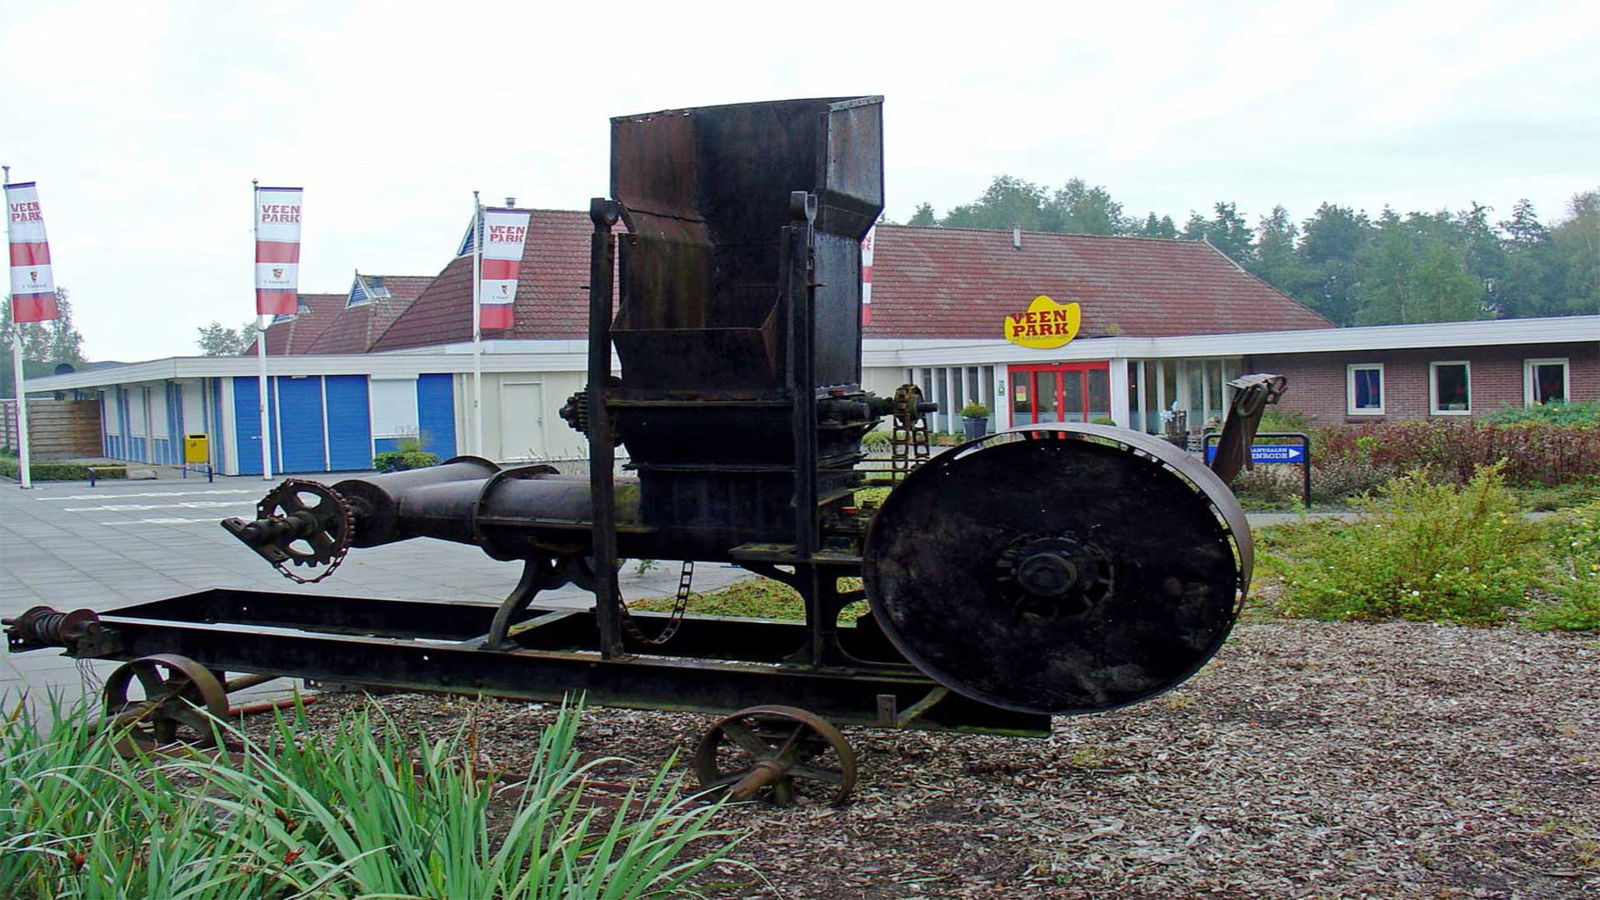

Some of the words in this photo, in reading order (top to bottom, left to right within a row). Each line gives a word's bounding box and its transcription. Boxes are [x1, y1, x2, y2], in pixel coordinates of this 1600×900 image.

[10, 201, 40, 212] VEEN
[262, 205, 300, 214] VEEN
[12, 212, 43, 222] PARK
[262, 213, 301, 223] PARK
[489, 225, 525, 234] VEEN
[490, 234, 524, 243] PARK
[1009, 310, 1067, 324] VEEN
[1012, 323, 1069, 337] PARK
